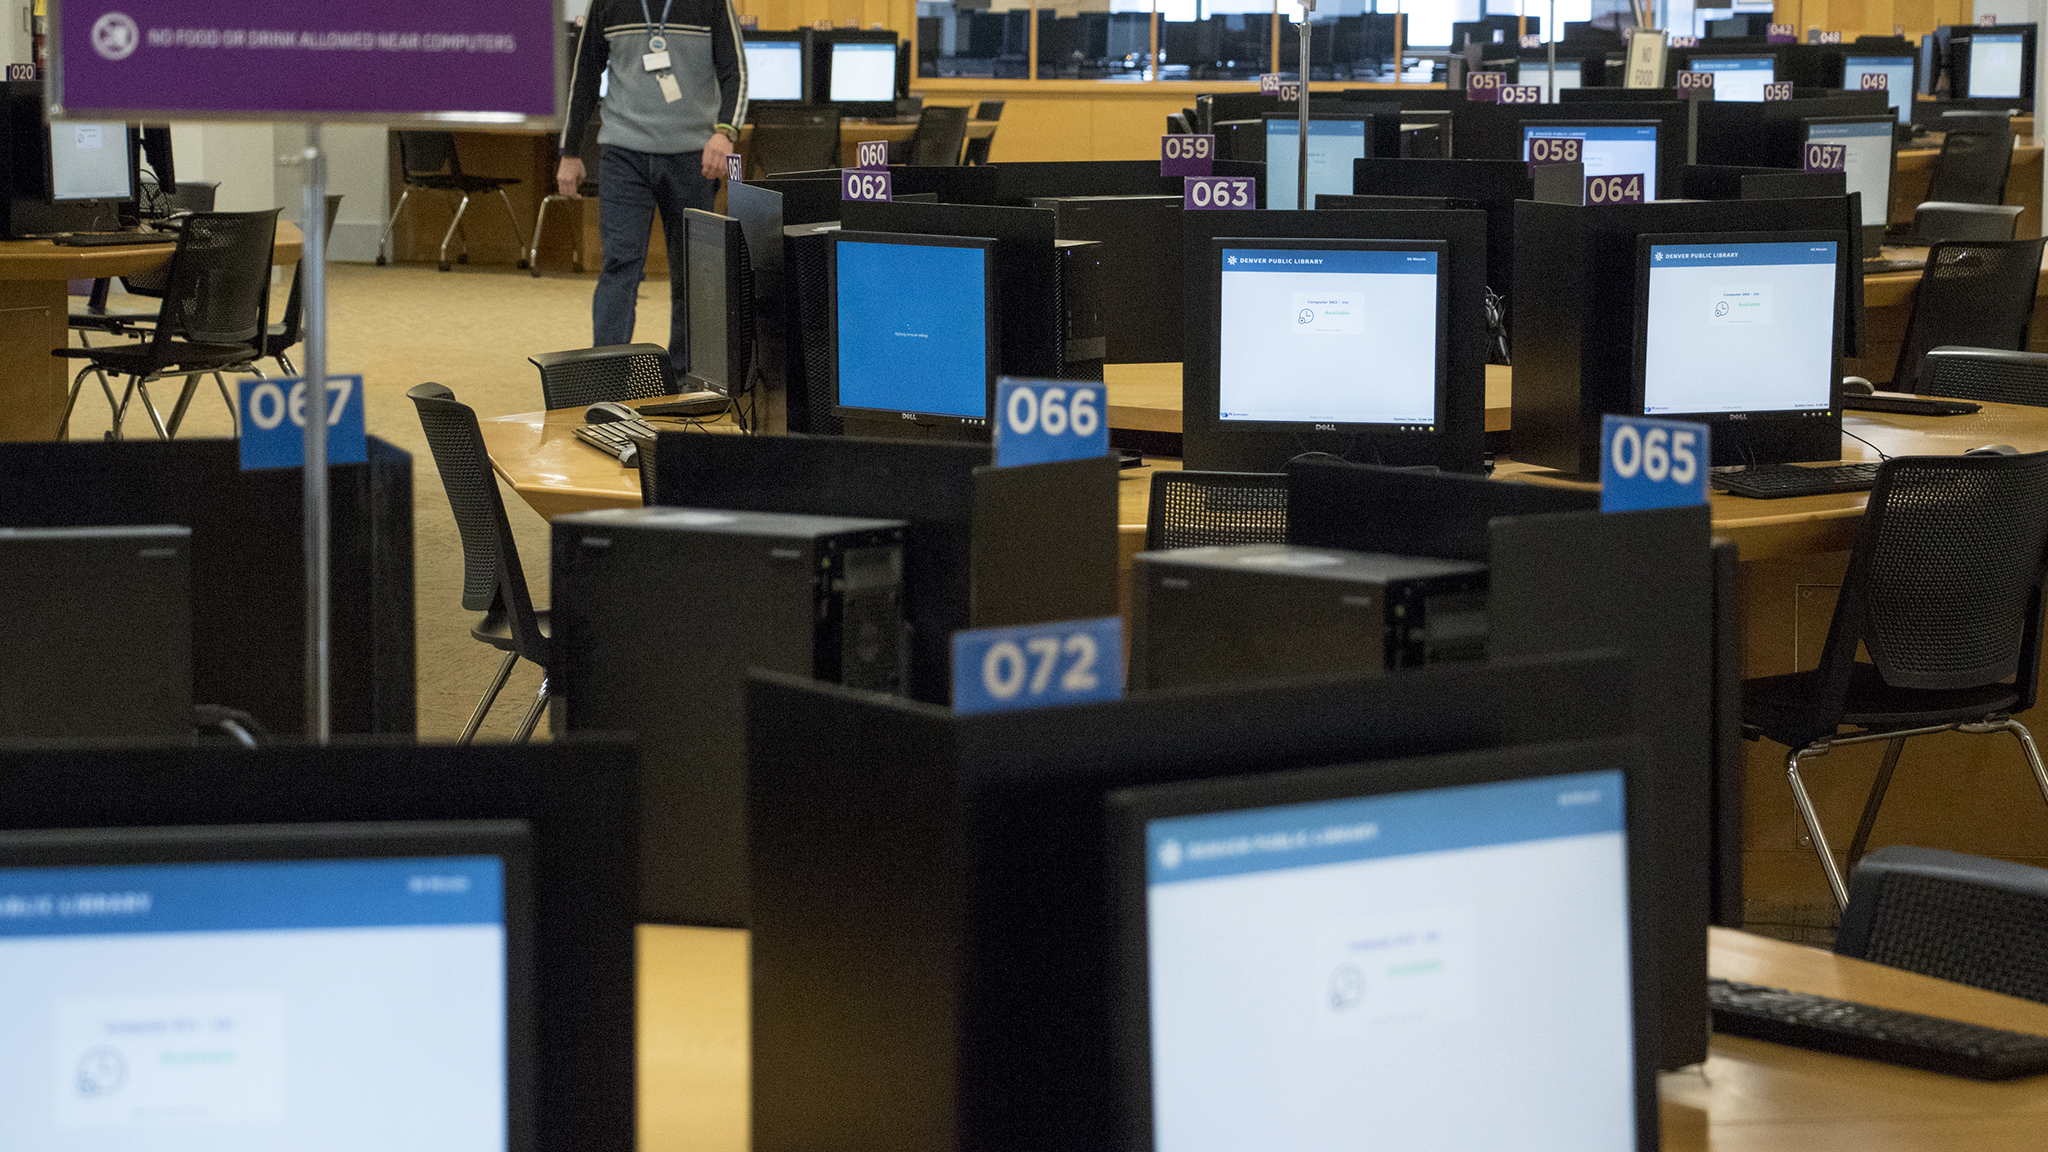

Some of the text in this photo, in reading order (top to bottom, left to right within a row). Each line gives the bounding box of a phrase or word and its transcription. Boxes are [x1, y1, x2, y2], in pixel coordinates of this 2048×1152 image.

[149, 29, 516, 53] NO FOOD OR DRINK ALLOWED NEAR COMPUTERS
[1642, 46, 1653, 63] NO
[12, 65, 34, 80] 020
[1472, 74, 1500, 89] 051
[1635, 68, 1654, 87] FOOD
[1681, 72, 1713, 88] 050
[1863, 73, 1886, 89] 049
[1262, 75, 1280, 91] 052
[1765, 84, 1790, 100] 056
[1281, 86, 1300, 101] 05
[1502, 87, 1538, 103] 055
[860, 143, 886, 167] 060
[1165, 138, 1209, 159] 059
[1533, 139, 1578, 162] 058
[1809, 145, 1842, 169] 057
[728, 158, 740, 181] 061
[847, 174, 887, 200] 062
[1192, 181, 1248, 207] 063
[1590, 176, 1640, 203] 064
[901, 412, 917, 420] DELL
[1007, 386, 1098, 437] 066
[1315, 423, 1337, 431] DELL
[1611, 424, 1697, 484] 065
[982, 633, 1098, 699] 072
